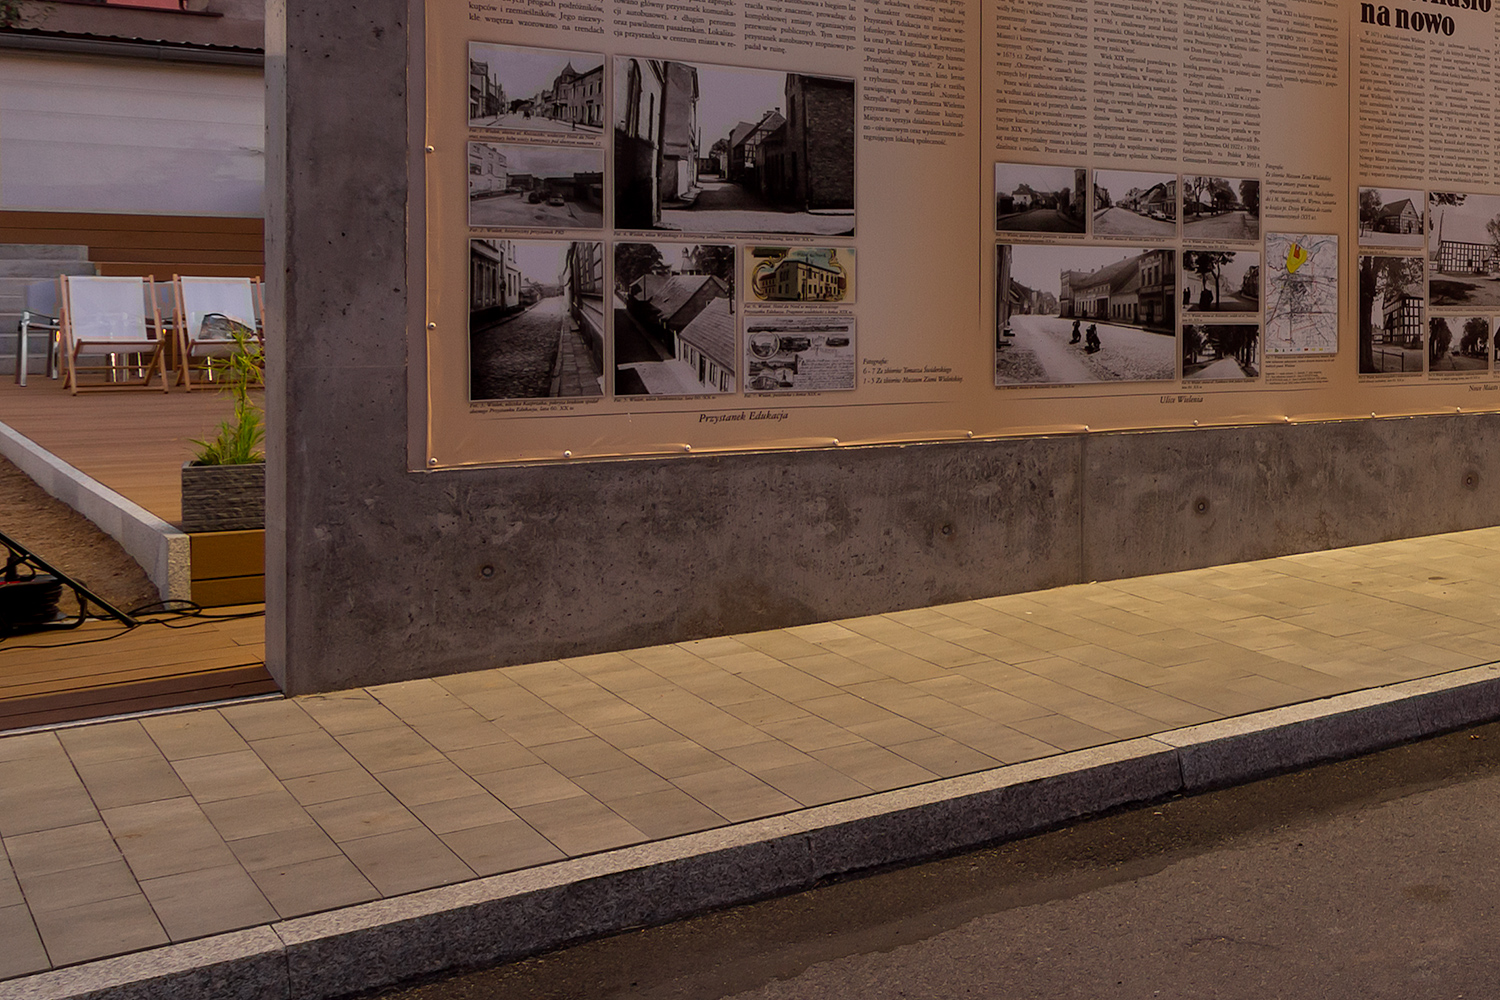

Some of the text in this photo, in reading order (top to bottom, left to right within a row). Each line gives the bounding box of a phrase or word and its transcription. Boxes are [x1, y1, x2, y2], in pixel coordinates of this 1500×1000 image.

[528, 0, 555, 7] progach
[469, 13, 480, 21] kle
[518, 21, 558, 29] wzorowano
[575, 26, 604, 34] trendach
[560, 12, 575, 21] Jego
[578, 16, 604, 24] niezwy-
[1360, 2, 1455, 36] na nowo
[698, 411, 788, 424] Przystanek Edukacja
